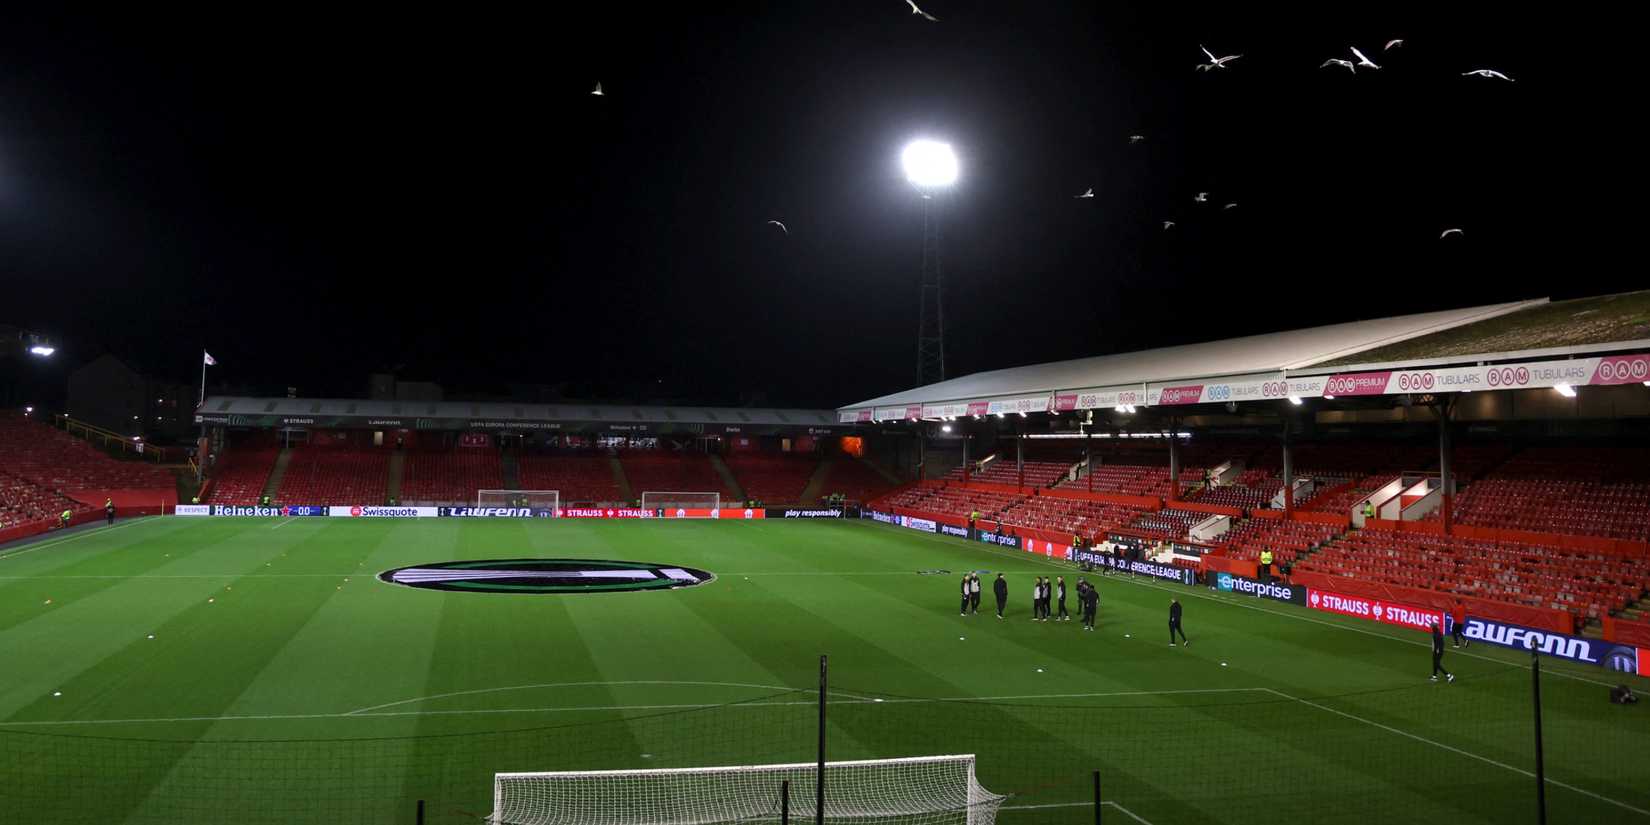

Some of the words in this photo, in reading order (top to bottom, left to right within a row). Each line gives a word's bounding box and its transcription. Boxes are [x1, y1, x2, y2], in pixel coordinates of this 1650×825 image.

[1487, 367, 1529, 387] RAM
[1533, 368, 1585, 380] TUBULARS
[1598, 360, 1648, 381] RAM
[1327, 378, 1354, 393] RAM
[1355, 377, 1384, 387] PREMIUM
[1399, 373, 1434, 390] RAM
[1436, 374, 1480, 385] TUBULARS
[1262, 382, 1287, 396] RAM
[214, 505, 278, 516] Heineken
[361, 507, 417, 517] Swissquote
[567, 509, 603, 517] STRAUSS
[617, 509, 654, 517] STRAUSS
[785, 509, 800, 519] play
[801, 509, 842, 519] responsibly
[1155, 566, 1182, 580] LEAGUE
[1222, 575, 1292, 600] enterprise
[1322, 595, 1369, 615] STRAUSS
